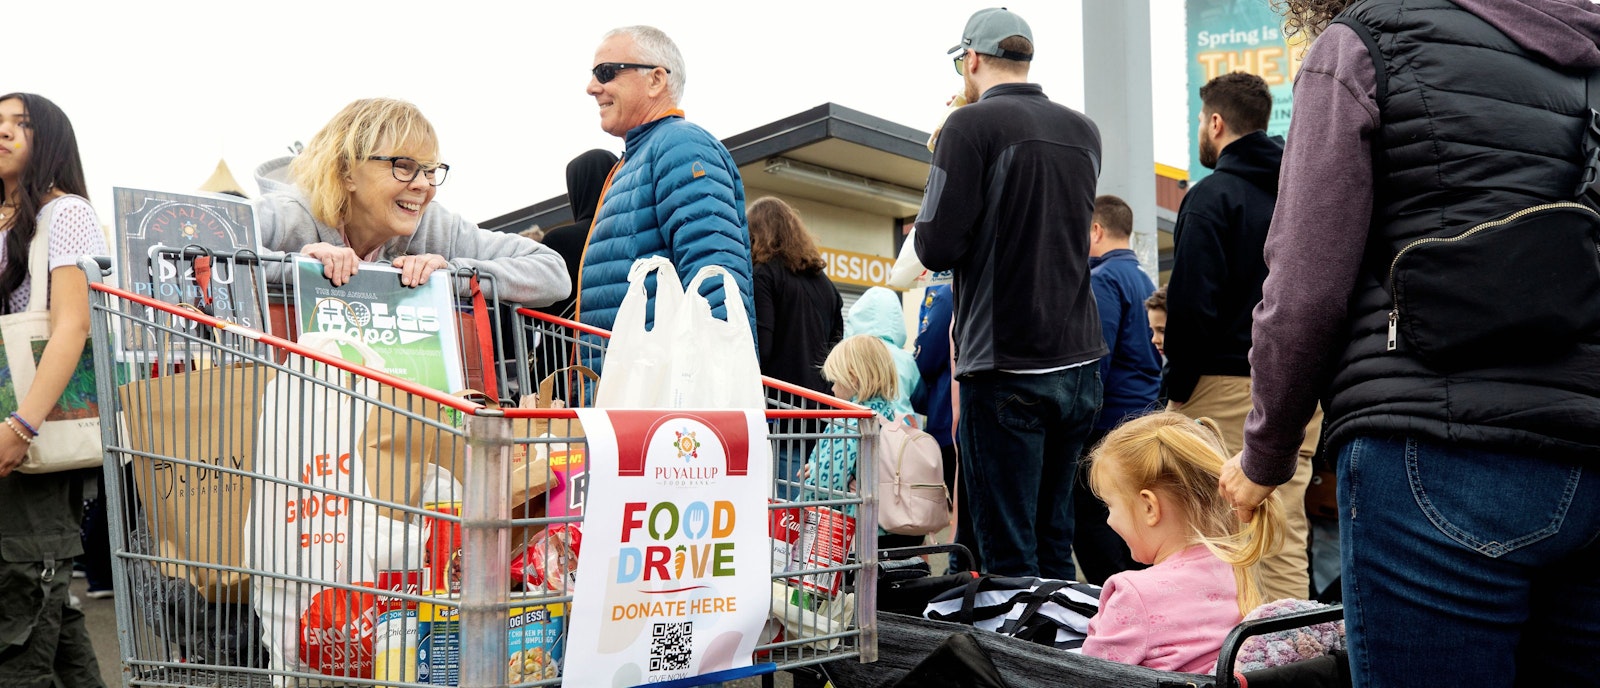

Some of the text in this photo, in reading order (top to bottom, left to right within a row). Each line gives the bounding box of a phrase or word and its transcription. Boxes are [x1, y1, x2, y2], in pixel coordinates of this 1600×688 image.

[1197, 25, 1279, 48] Spring is
[151, 206, 225, 240] PUYALLUP
[347, 291, 378, 300] ANNUAL
[196, 298, 245, 312] AOUT
[550, 453, 582, 467] NEW!
[655, 466, 718, 480] PUYALLUP
[620, 500, 736, 543] FOOD
[616, 542, 736, 584] DRIVE
[384, 610, 415, 620] COOKNG
[611, 597, 737, 621] DONATE HERE
[510, 610, 546, 628] OGESS
[386, 628, 418, 640] Chicen
[511, 629, 536, 638] CHIKEN
[648, 672, 689, 684] GIVE NOW
